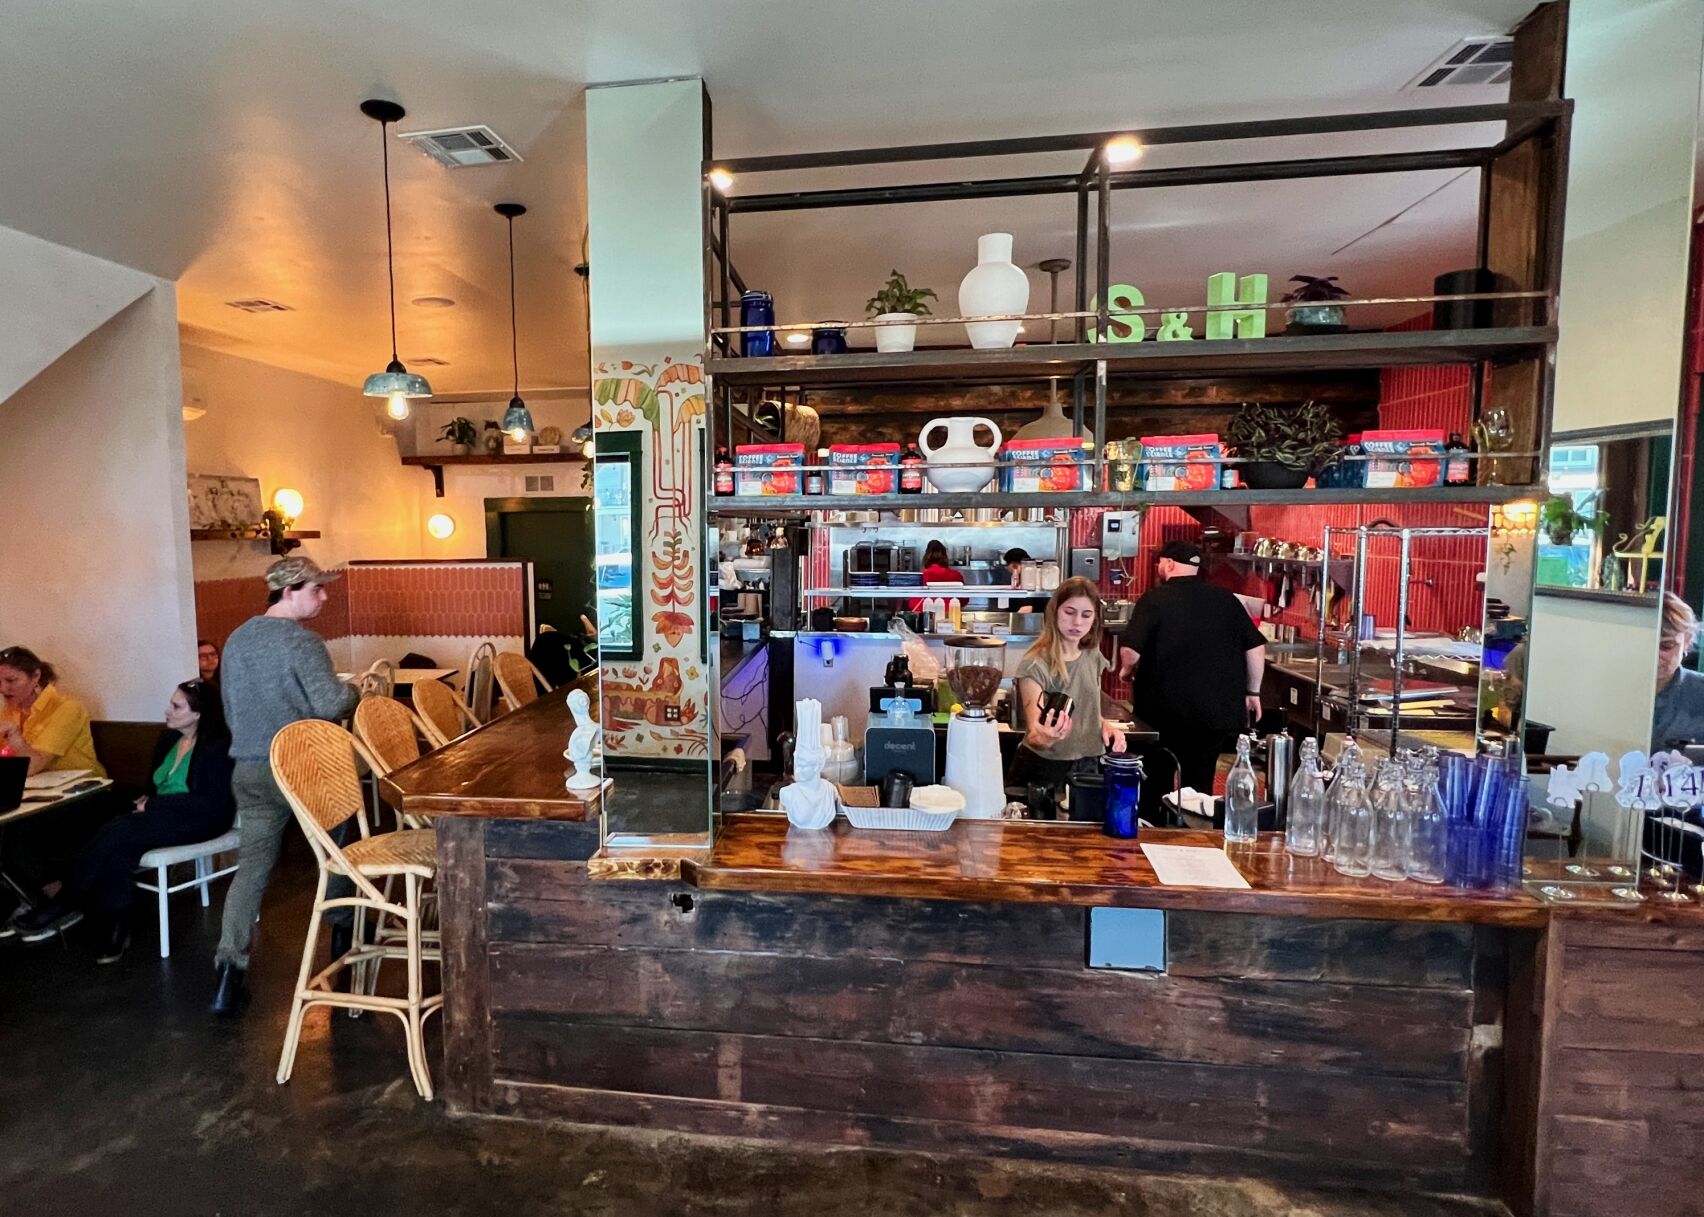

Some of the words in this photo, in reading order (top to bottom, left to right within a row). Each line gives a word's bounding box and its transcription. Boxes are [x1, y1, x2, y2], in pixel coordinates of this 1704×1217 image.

[1088, 284, 1145, 343] S
[1157, 312, 1194, 341] &
[1206, 272, 1268, 339] H
[1666, 772, 1699, 797] 14
